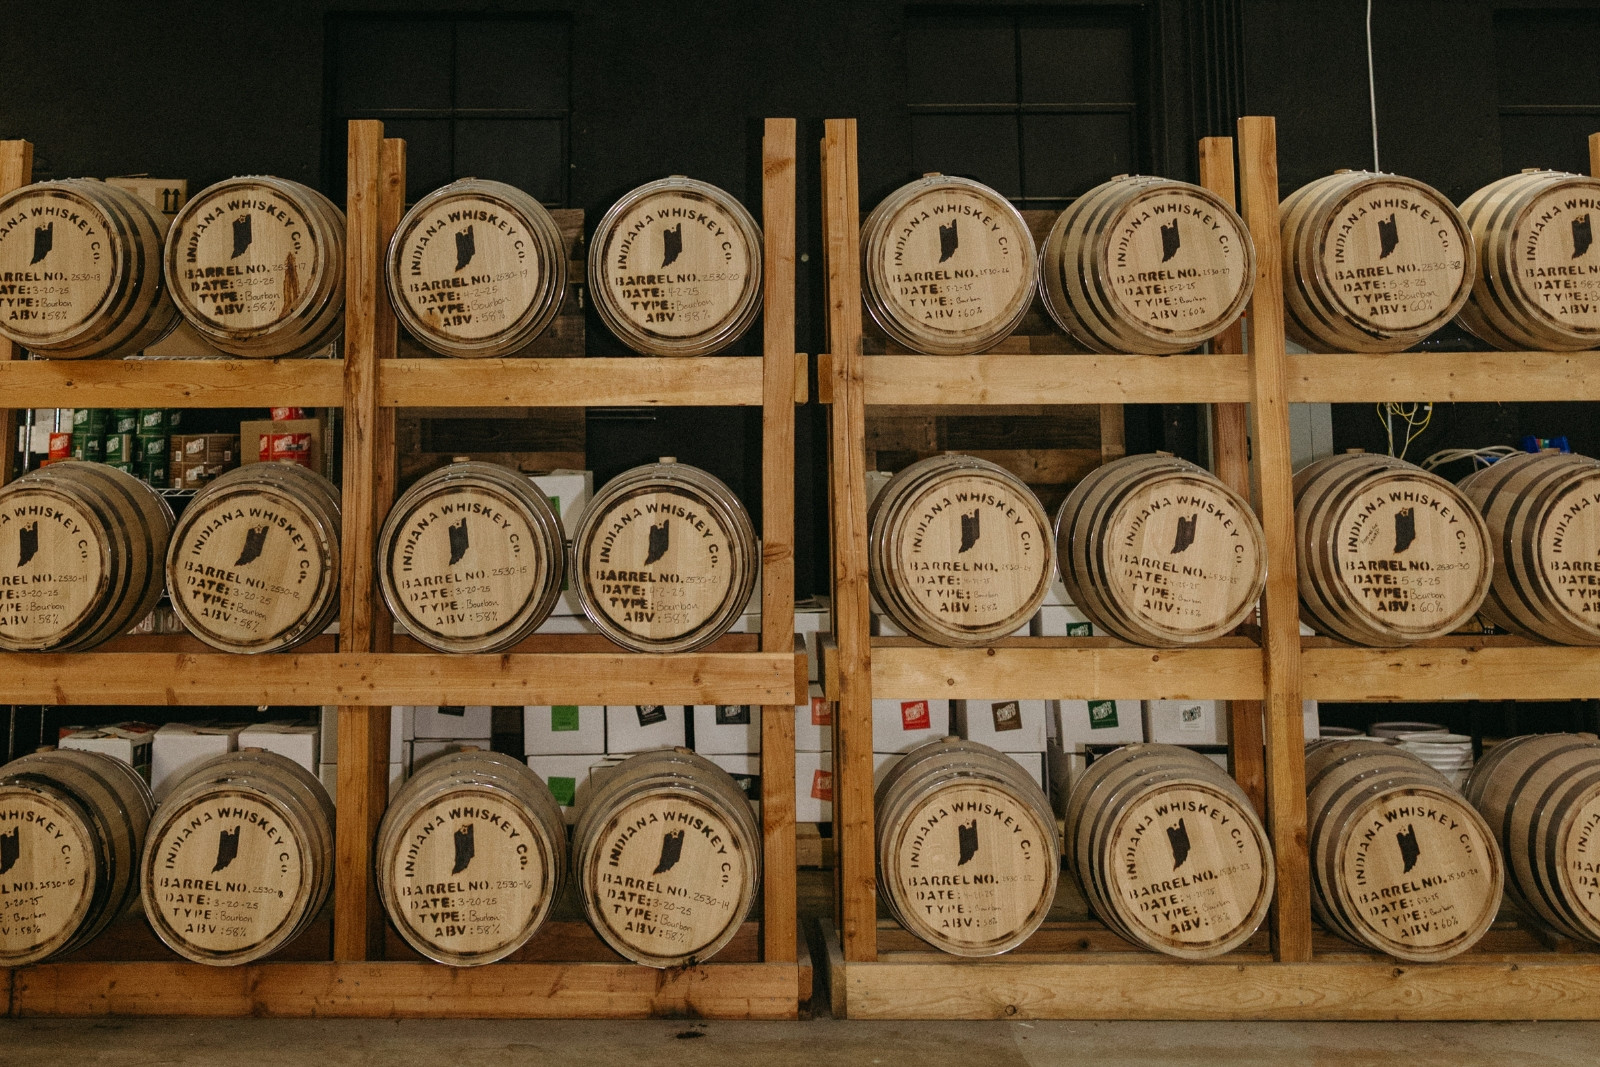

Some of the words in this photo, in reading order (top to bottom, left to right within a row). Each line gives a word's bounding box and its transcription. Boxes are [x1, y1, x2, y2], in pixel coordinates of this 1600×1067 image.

[31, 206, 95, 237] WHISKEY
[187, 207, 225, 263] INDIANA
[227, 200, 295, 227] WHISKEY
[618, 215, 655, 270] INDIANA
[657, 208, 725, 238] WHISKEY
[894, 211, 931, 266] INDIANA
[932, 204, 1001, 232] WHISKEY
[1117, 211, 1152, 268] INDIANA
[1152, 203, 1221, 230] WHISKEY
[1335, 207, 1368, 264] INDIANA
[1368, 199, 1440, 225] WHISKEY
[1526, 205, 1562, 261] INDIANA
[411, 220, 447, 276] INDIANA
[448, 210, 516, 237] WHISKEY
[185, 266, 244, 279] BARREL
[246, 264, 270, 274] NO.
[893, 271, 952, 283] BARREL
[1116, 270, 1175, 284] BARREL
[1335, 266, 1394, 280] BARREL
[1396, 262, 1421, 273] NO.
[1525, 265, 1586, 278] BARREL
[235, 277, 275, 287] 3-20-25
[410, 277, 470, 293] BARREL
[615, 274, 674, 286] BARREL
[676, 273, 701, 283] NO.
[1389, 279, 1427, 290] 5-8-25
[33, 286, 70, 294] 3-20-25
[244, 290, 280, 302] Bourbon
[1398, 290, 1440, 302] Bourbon
[41, 298, 72, 307] Bourbon
[214, 303, 251, 316] ABV:
[252, 301, 276, 312] 58%
[471, 297, 511, 311] Bourbon
[1369, 304, 1407, 316] ABV:
[9, 311, 46, 320] ABV:
[48, 311, 67, 320] 58%
[14, 505, 81, 536] WHISKEY
[913, 497, 952, 553] INDIANA
[955, 492, 1023, 526] WHISKEY
[1124, 497, 1171, 547] INDIANA
[1176, 495, 1240, 538] WHISKEY
[1347, 497, 1385, 553] INDIANA
[1389, 491, 1458, 525] WHISKEY
[1552, 497, 1591, 553] INDIANA
[191, 508, 245, 556] INDIANA
[249, 507, 308, 553] WHISKEY
[402, 511, 438, 572] INDIANA
[441, 503, 512, 530] WHISKEY
[600, 508, 642, 563] INDIANA
[645, 503, 713, 539] WHISKEY
[909, 561, 971, 572] BARREL
[1120, 553, 1179, 574] BARREL
[1346, 560, 1407, 572] BARREL
[1410, 560, 1435, 572] NO.
[184, 561, 242, 585] BARREL
[245, 577, 269, 592] NO.
[401, 573, 463, 589] BARREL
[465, 570, 490, 582] NO.
[596, 570, 657, 583] BARREL
[916, 575, 961, 586] DATE:
[1124, 569, 1168, 585] DATE:
[1353, 574, 1398, 585] DATE:
[1400, 576, 1441, 586] 5-8-25
[21, 589, 59, 598] 3-20-25
[233, 588, 272, 606] 3-20-25
[455, 585, 491, 596] 3-20-25
[1131, 583, 1175, 601] TYPE:
[1361, 587, 1408, 599] TYPE:
[1410, 588, 1445, 600] Bourbon
[30, 602, 65, 611] Bourbon
[236, 602, 268, 620] Bourbon
[466, 600, 500, 610] Bourbon
[609, 597, 655, 609] TYPE:
[656, 600, 699, 611] Bourbon
[1377, 601, 1415, 612] ABV:
[1419, 601, 1444, 613] 60%
[39, 615, 59, 625] 58%
[435, 613, 473, 626] ABV:
[475, 611, 499, 623] 58%
[624, 612, 661, 623] ABV:
[663, 612, 690, 624] 58%
[165, 811, 213, 870] INDIANA
[217, 807, 285, 846] WHISKEY
[404, 815, 446, 878] INDIANA
[448, 806, 521, 839] WHISKEY
[608, 812, 659, 867] INDIANA
[663, 811, 728, 856] WHISKEY
[910, 808, 949, 868] INDIANA
[951, 801, 1022, 834] WHISKEY
[1126, 815, 1153, 881] INDIANA
[1154, 801, 1230, 827] WHISKEY
[1356, 820, 1384, 886] INDIANA
[1384, 806, 1458, 831] WHISKEY
[160, 878, 222, 892] BARREL
[402, 881, 466, 896] BARREL
[468, 880, 494, 890] NO.
[602, 873, 663, 894] BARREL
[666, 884, 692, 900] NO.
[908, 874, 971, 887] BARREL
[1129, 876, 1191, 900] BARREL
[916, 889, 961, 901] DATE:
[1359, 880, 1420, 904] BARREL
[5, 895, 44, 909] 3-20-25
[165, 893, 210, 905] DATE:
[213, 899, 259, 910] 3-20-25
[410, 897, 455, 910] DATE:
[457, 897, 498, 907] 3-20-25
[607, 889, 651, 907] DATE:
[651, 899, 693, 917] 3-20-25
[925, 904, 972, 915] TYPE:
[1140, 894, 1185, 912] DATE:
[1369, 898, 1414, 917] DATE:
[173, 907, 219, 920] TYPE:
[220, 910, 253, 923] Bourbon
[418, 911, 466, 924] TYPE:
[613, 903, 658, 923] TYPE:
[660, 913, 693, 931] Bourbon
[1381, 909, 1427, 928] TYPE:
[21, 924, 41, 935] 58%
[225, 926, 247, 937] 58%
[434, 925, 474, 938] ABV:
[476, 924, 501, 935] 58%
[624, 921, 663, 938] ABV:
[665, 929, 686, 943] 58%
[1170, 918, 1209, 935] ABV:
